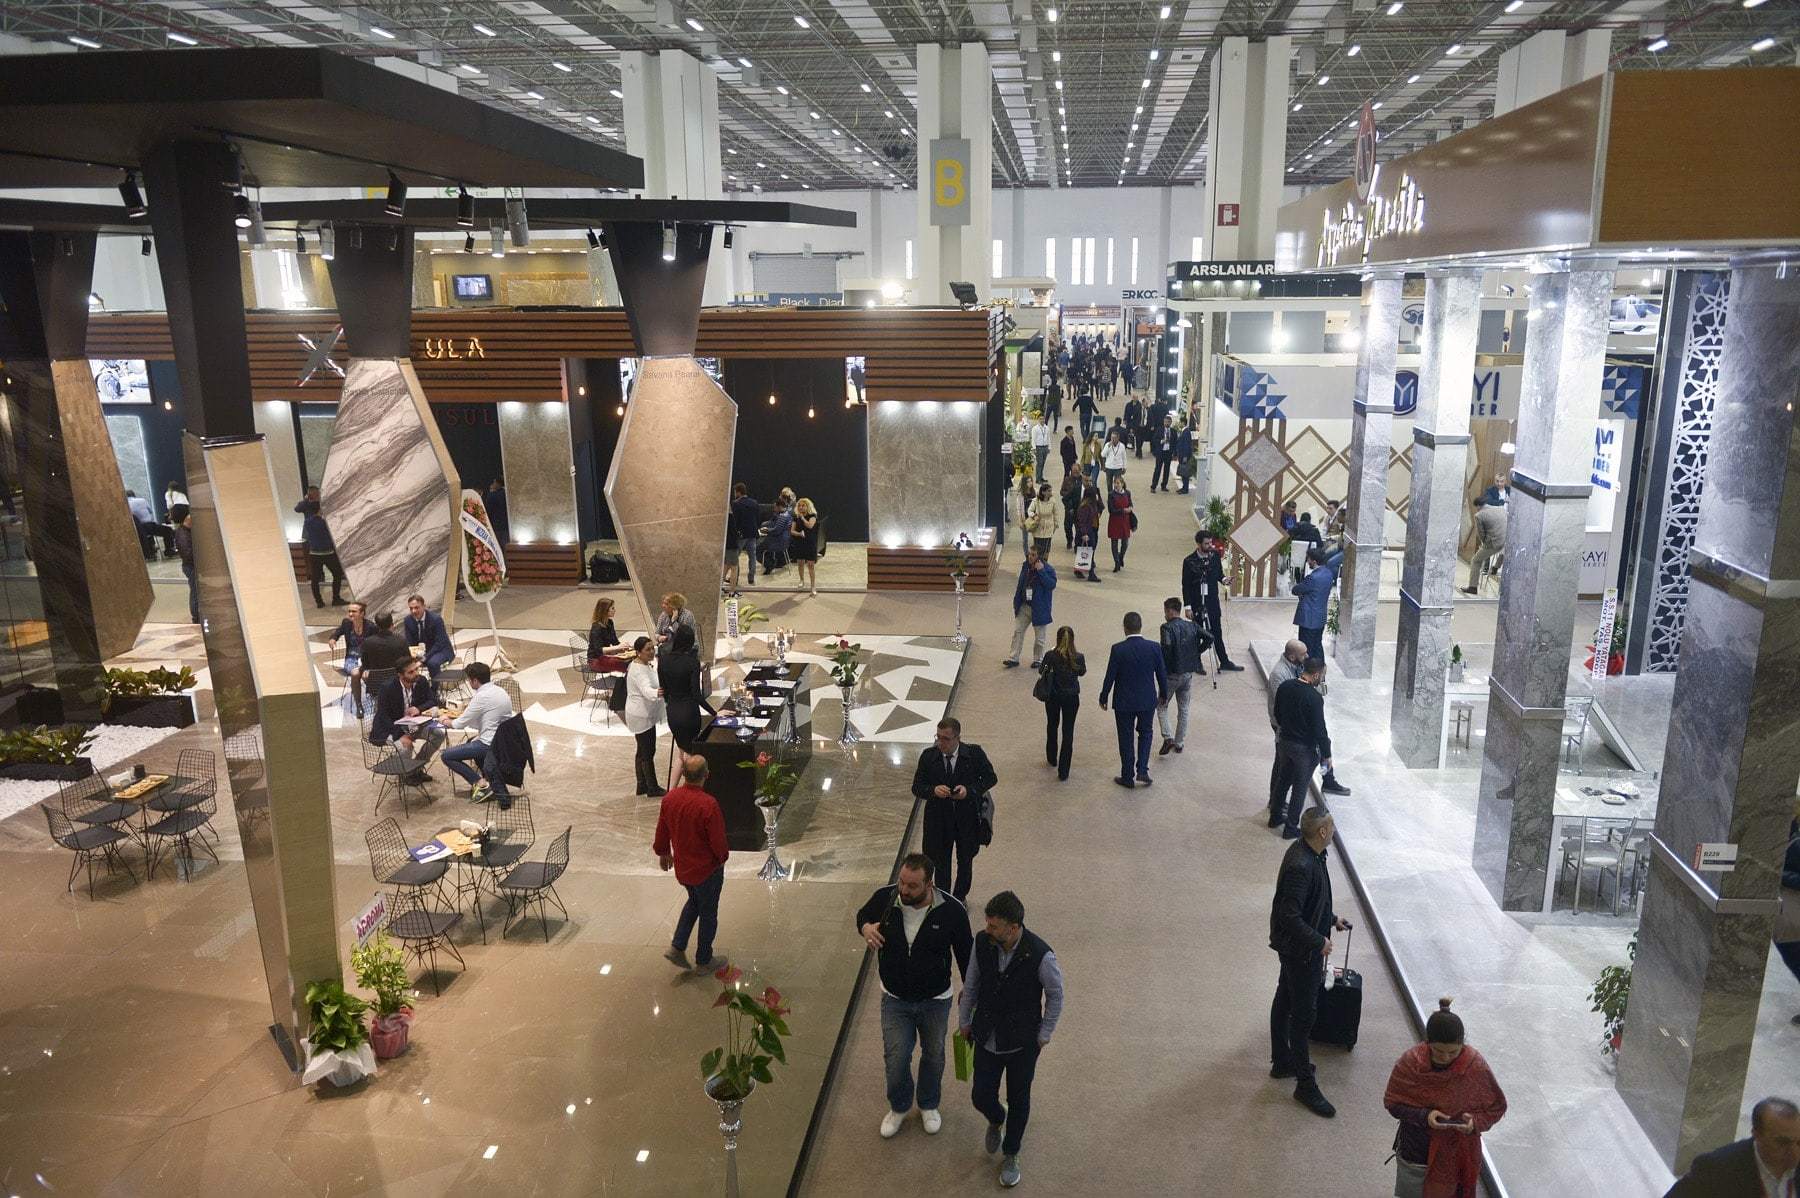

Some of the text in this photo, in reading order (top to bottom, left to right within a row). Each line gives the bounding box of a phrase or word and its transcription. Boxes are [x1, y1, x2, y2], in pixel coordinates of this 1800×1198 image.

[935, 159, 966, 207] B
[1190, 263, 1276, 276] ARSLANLAR
[780, 297, 810, 306] Black
